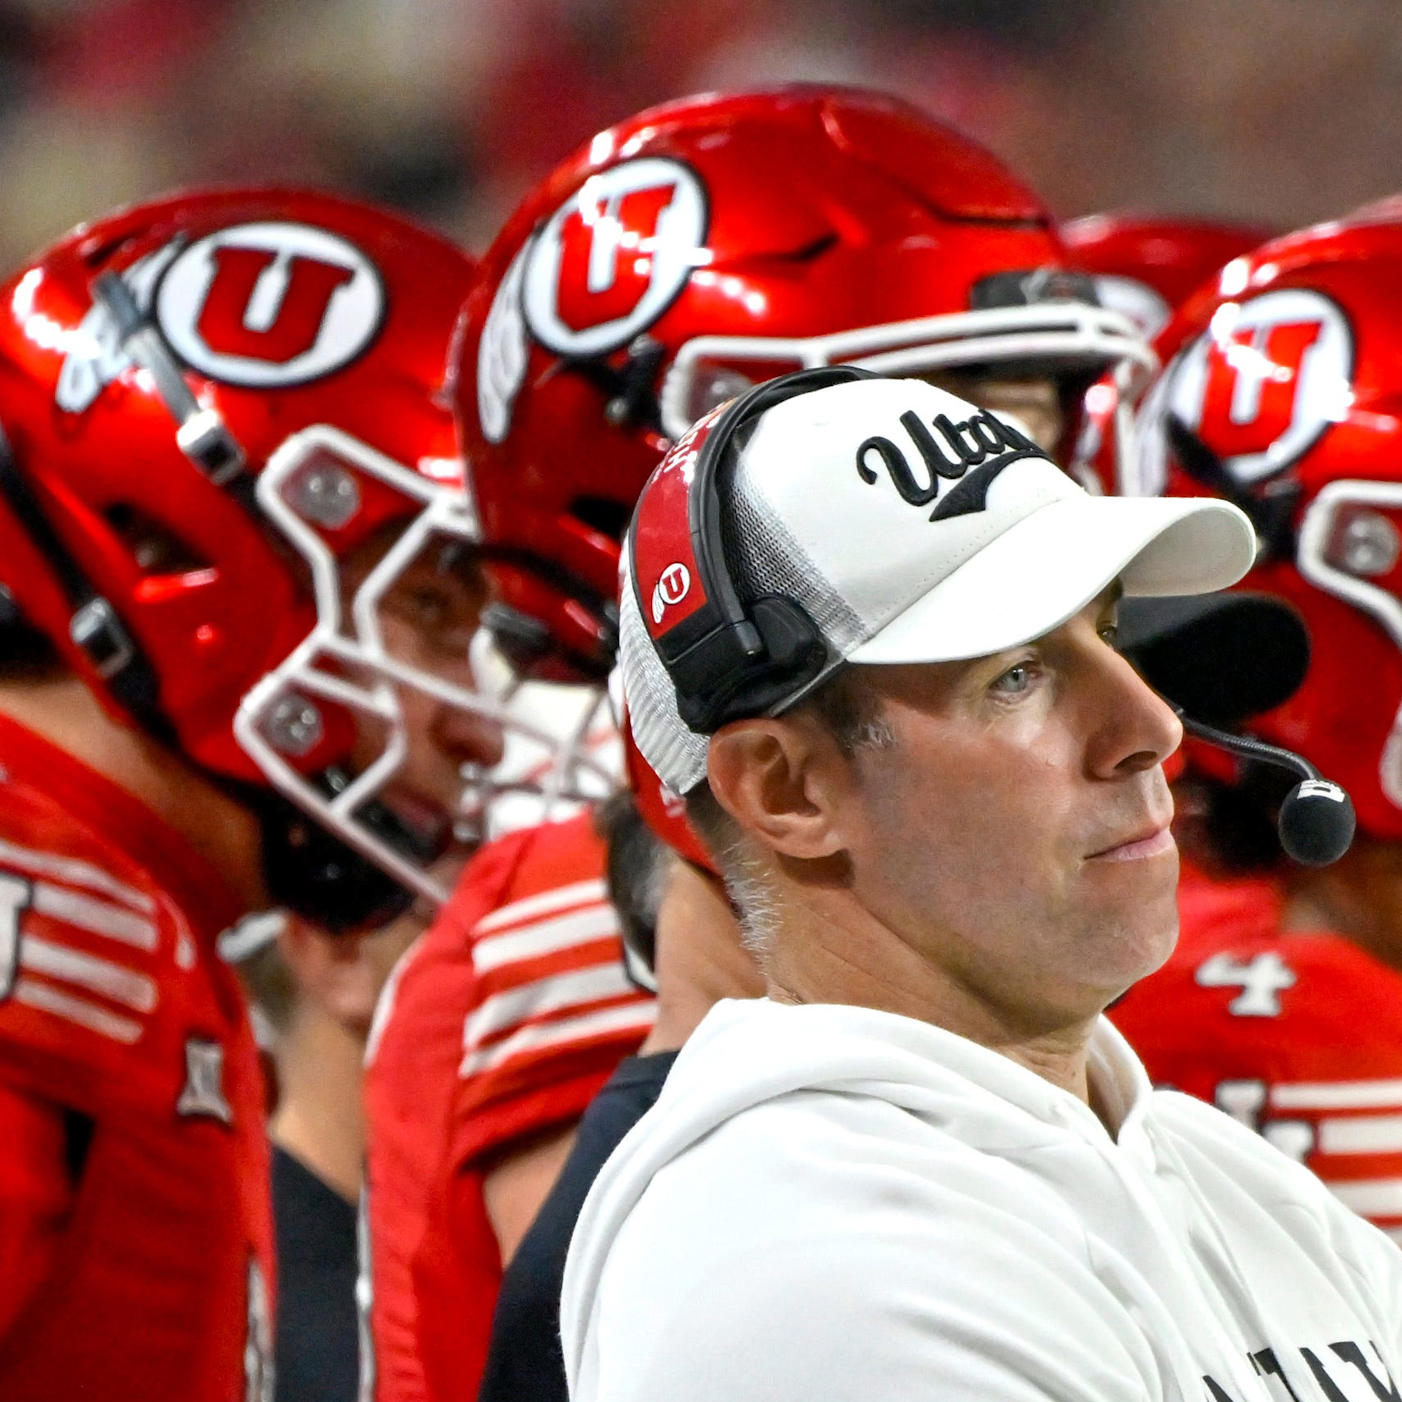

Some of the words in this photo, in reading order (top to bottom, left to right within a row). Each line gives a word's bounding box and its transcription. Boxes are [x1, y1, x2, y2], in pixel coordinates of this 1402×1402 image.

[195, 245, 354, 365] U
[553, 183, 697, 335] U
[1198, 320, 1322, 457] U
[662, 567, 684, 600] U
[1195, 953, 1297, 1017] 4
